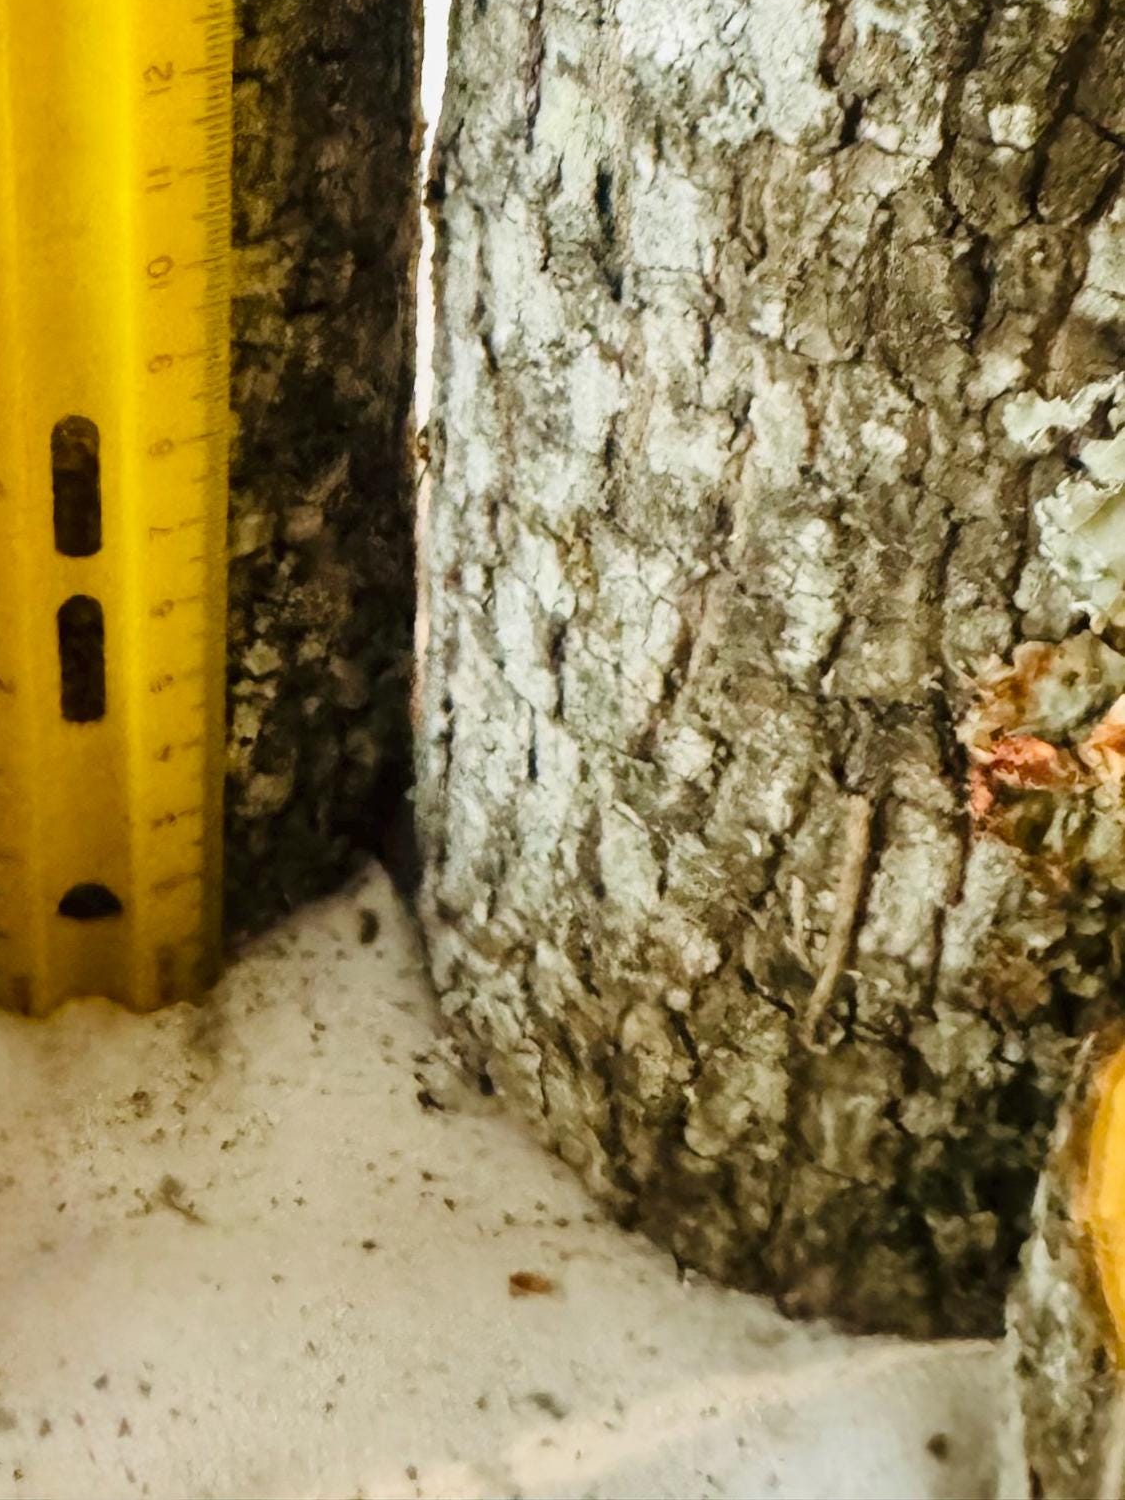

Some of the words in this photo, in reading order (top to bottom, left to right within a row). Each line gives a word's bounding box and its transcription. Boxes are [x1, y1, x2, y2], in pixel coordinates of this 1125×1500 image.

[143, 61, 174, 96] 12
[145, 165, 173, 194] 11
[147, 255, 174, 290] 10
